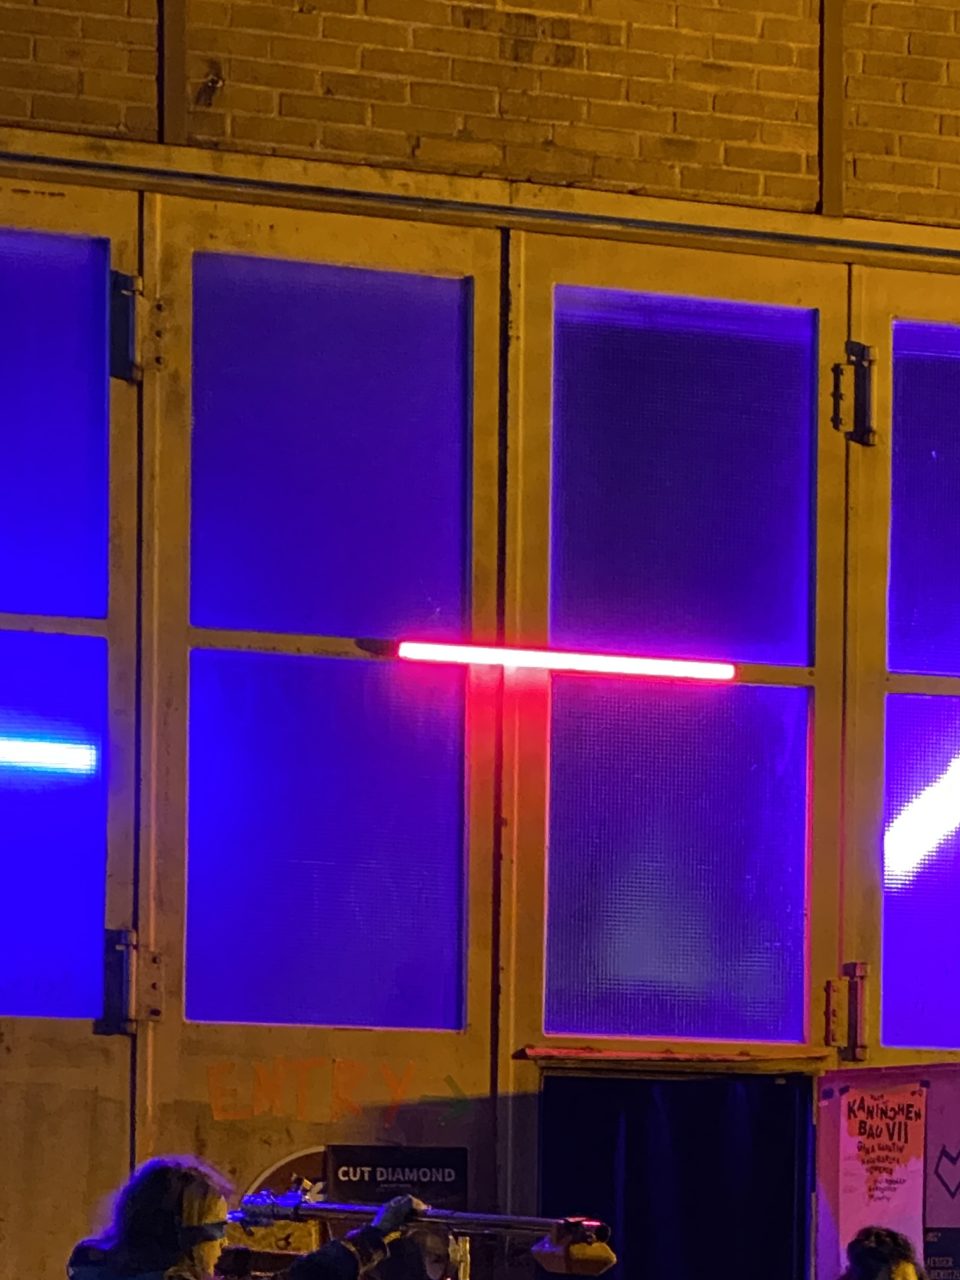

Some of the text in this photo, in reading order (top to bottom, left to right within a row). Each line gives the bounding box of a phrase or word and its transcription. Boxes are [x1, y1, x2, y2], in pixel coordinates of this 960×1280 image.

[207, 1058, 416, 1128] ENTRY
[858, 1120, 909, 1144] BAU VII
[338, 1166, 456, 1182] CUT DIAMOND
